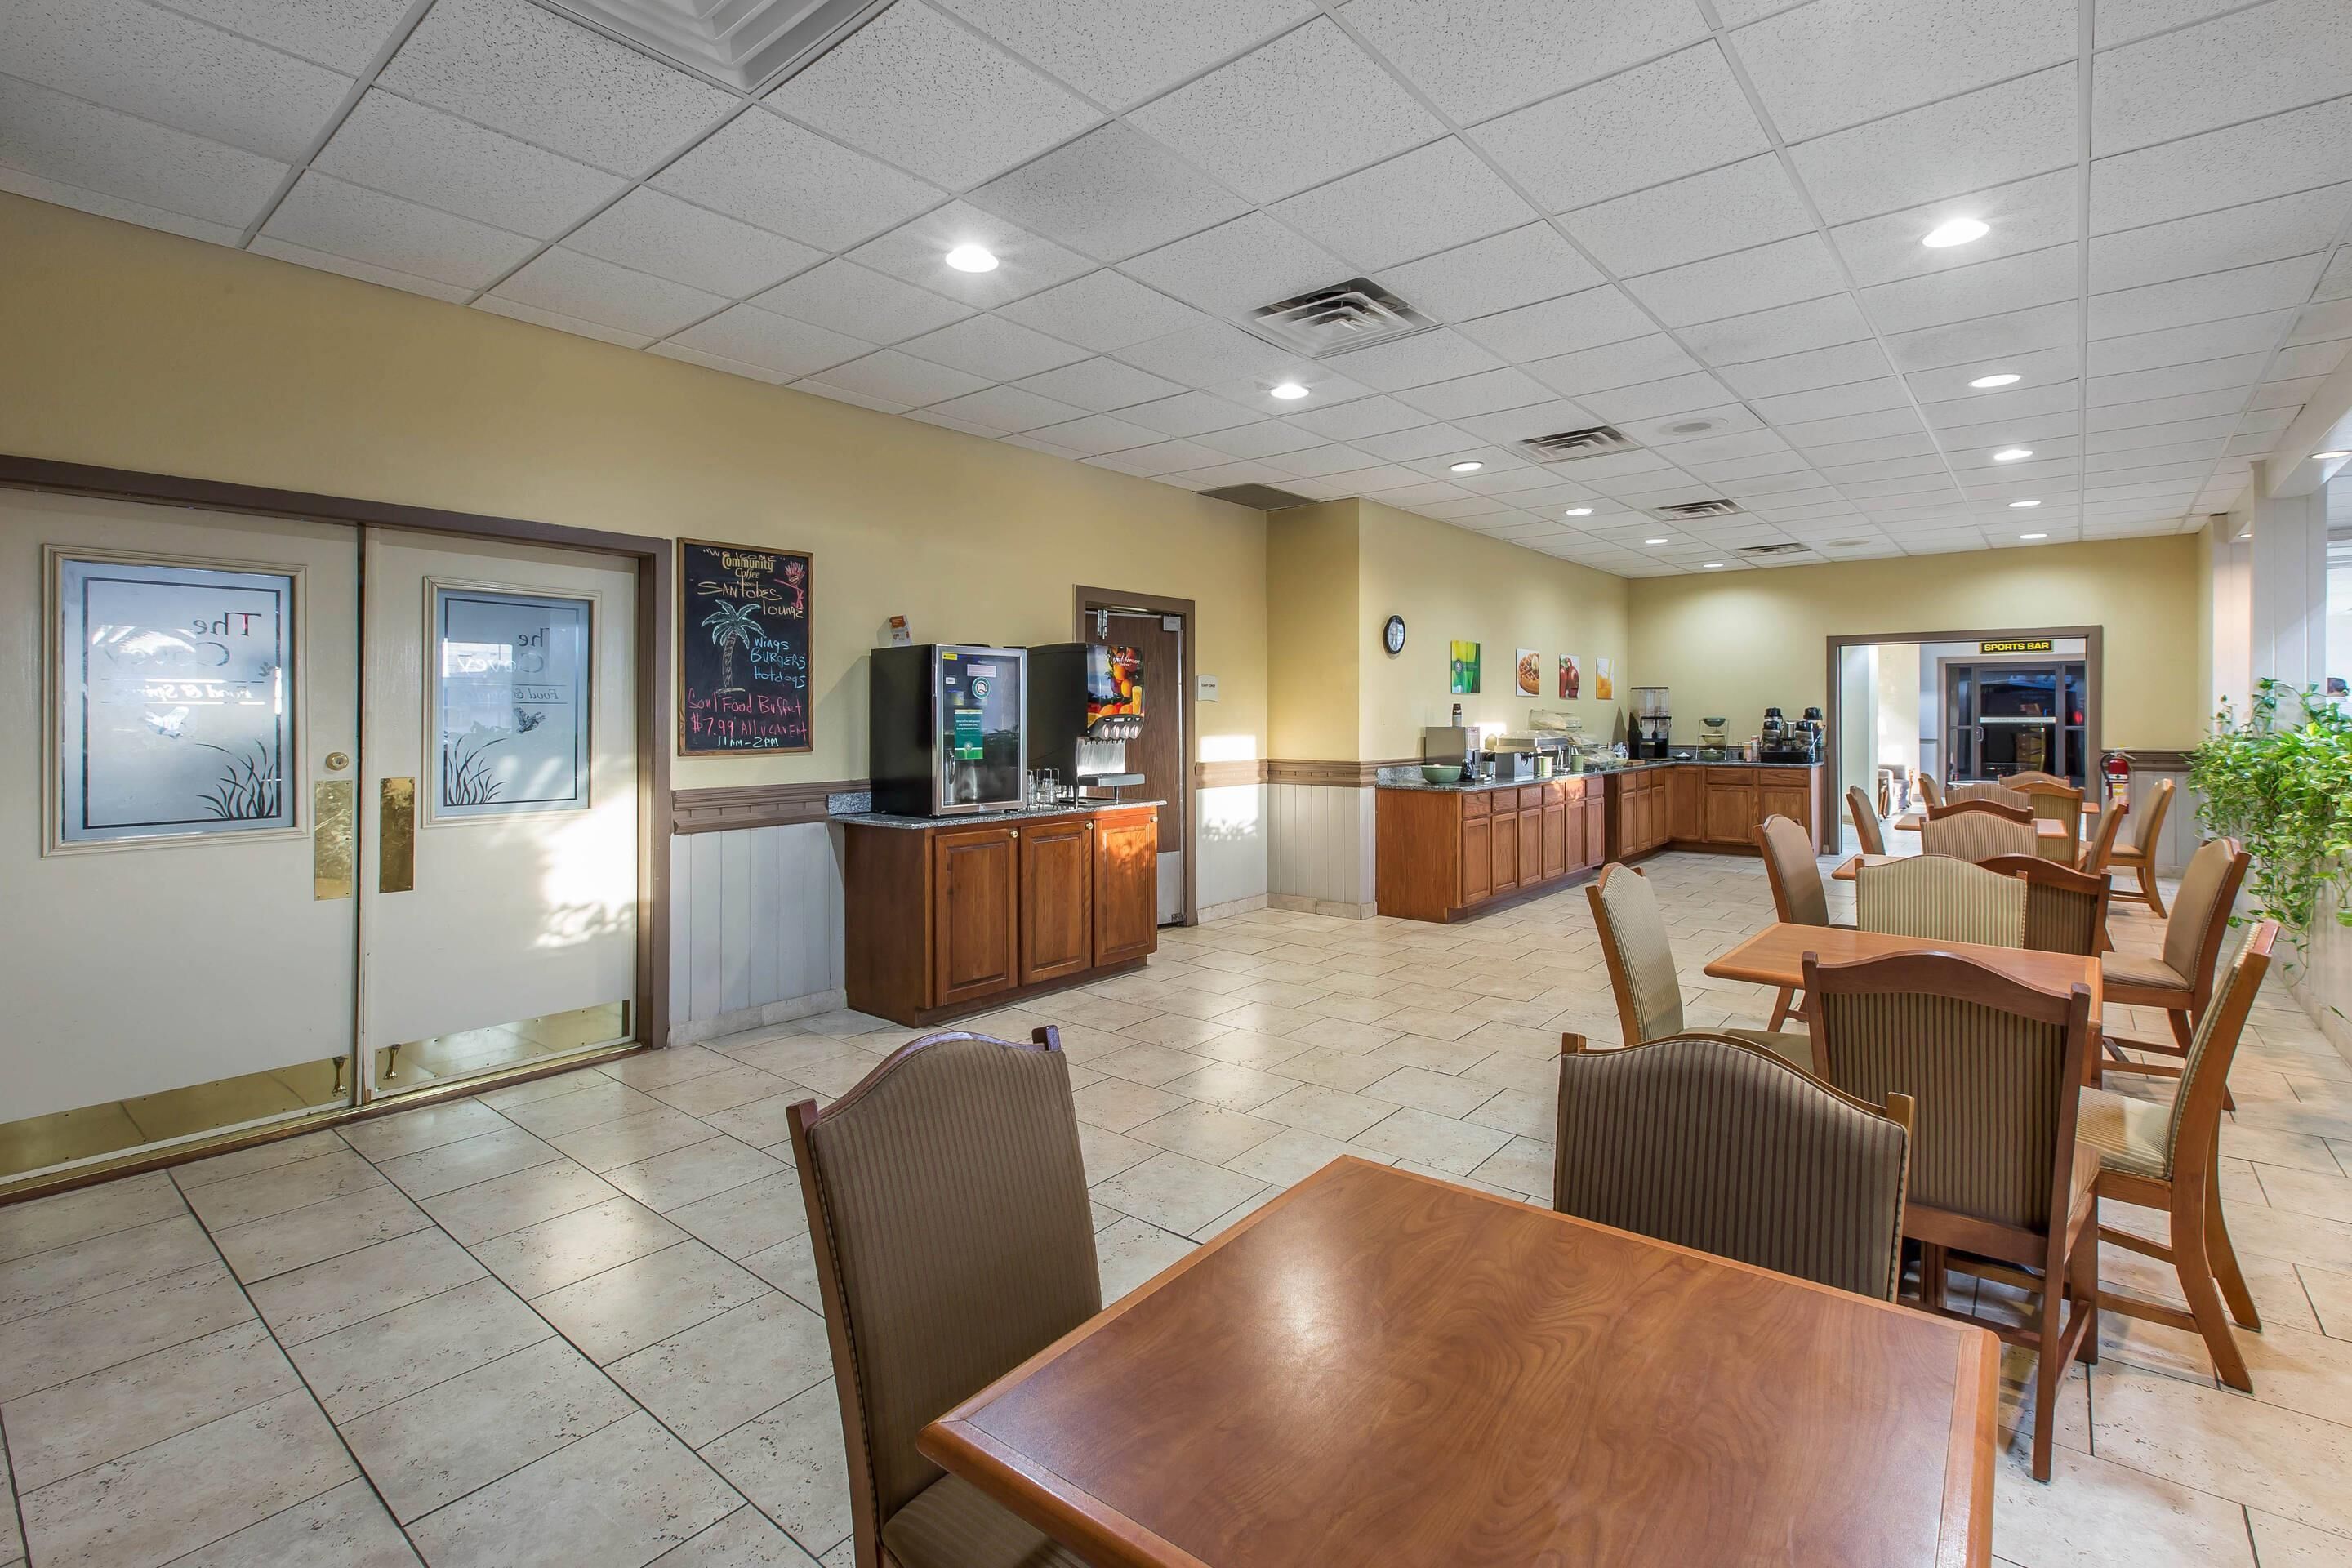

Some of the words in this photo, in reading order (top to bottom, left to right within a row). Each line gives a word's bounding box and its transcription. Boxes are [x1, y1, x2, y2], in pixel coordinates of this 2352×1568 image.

[722, 555, 773, 572] Community
[735, 568, 760, 579] Coffee
[1984, 643, 2025, 652] SPORTS
[2027, 642, 2049, 650] BAR
[688, 688, 718, 713] Soul
[722, 693, 752, 714] Food
[757, 694, 802, 718] Buffet
